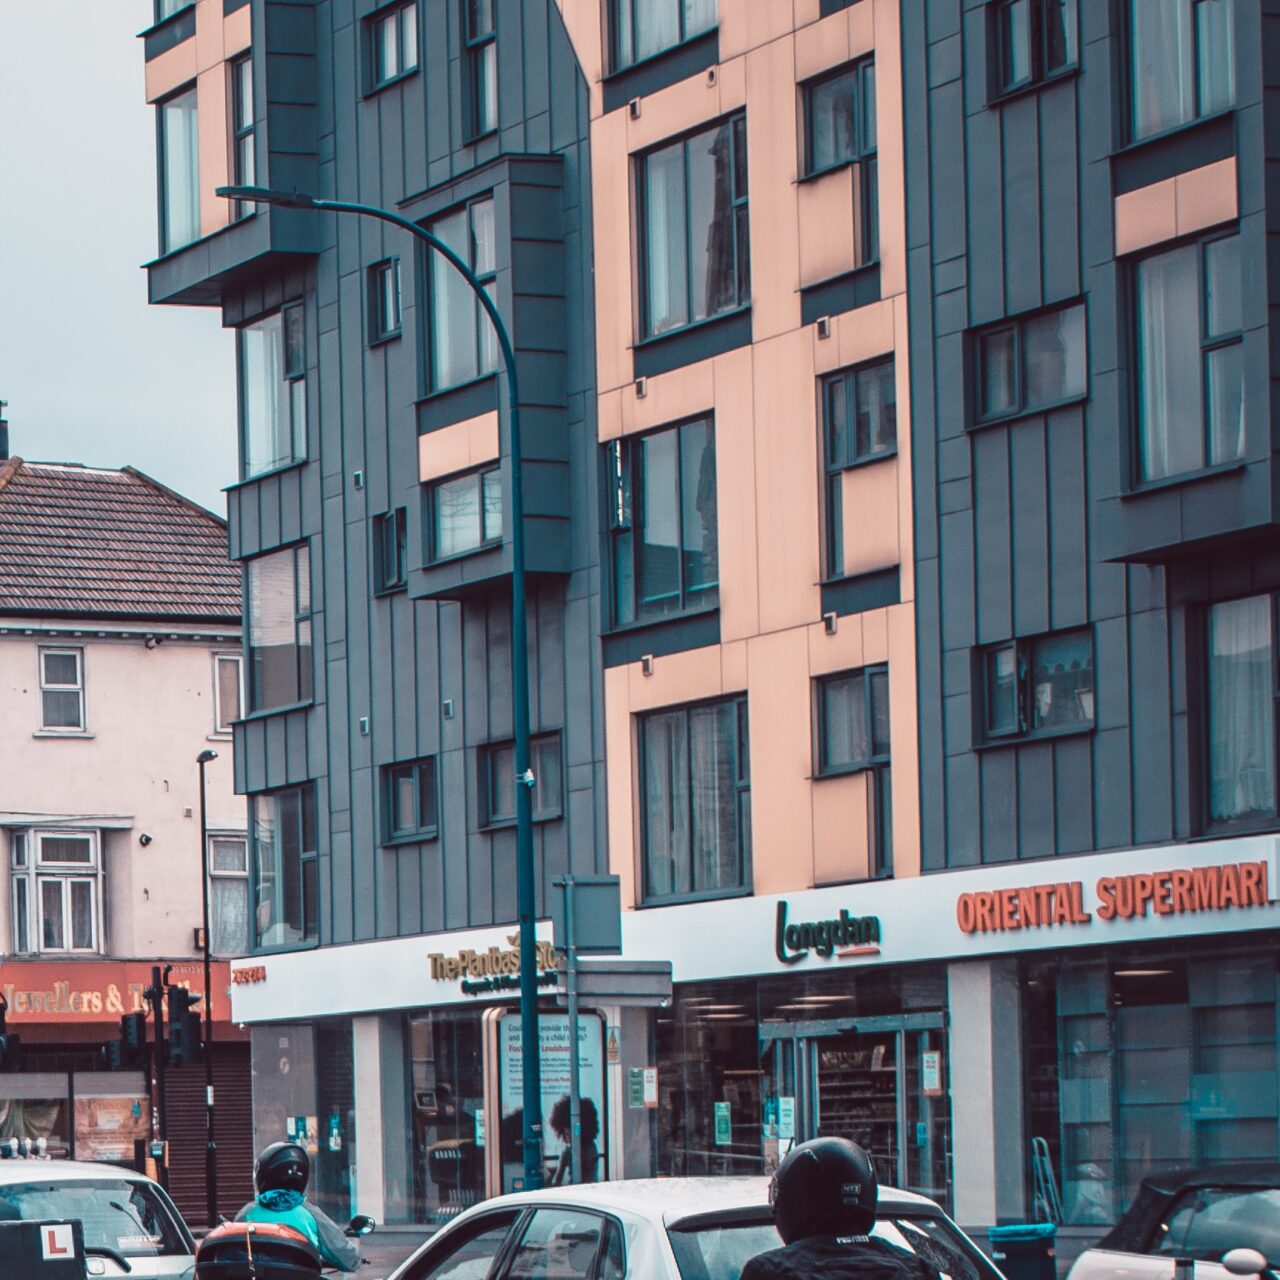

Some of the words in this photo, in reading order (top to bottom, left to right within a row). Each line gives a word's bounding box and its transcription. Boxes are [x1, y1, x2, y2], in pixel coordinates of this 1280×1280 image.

[957, 881, 1091, 933] ORIENTAL
[776, 900, 881, 964] Longdan
[427, 952, 458, 981] The
[458, 946, 521, 978] Plantbas
[3, 980, 102, 1020] Jewellers
[106, 983, 124, 1014] &
[48, 1230, 67, 1254] L
